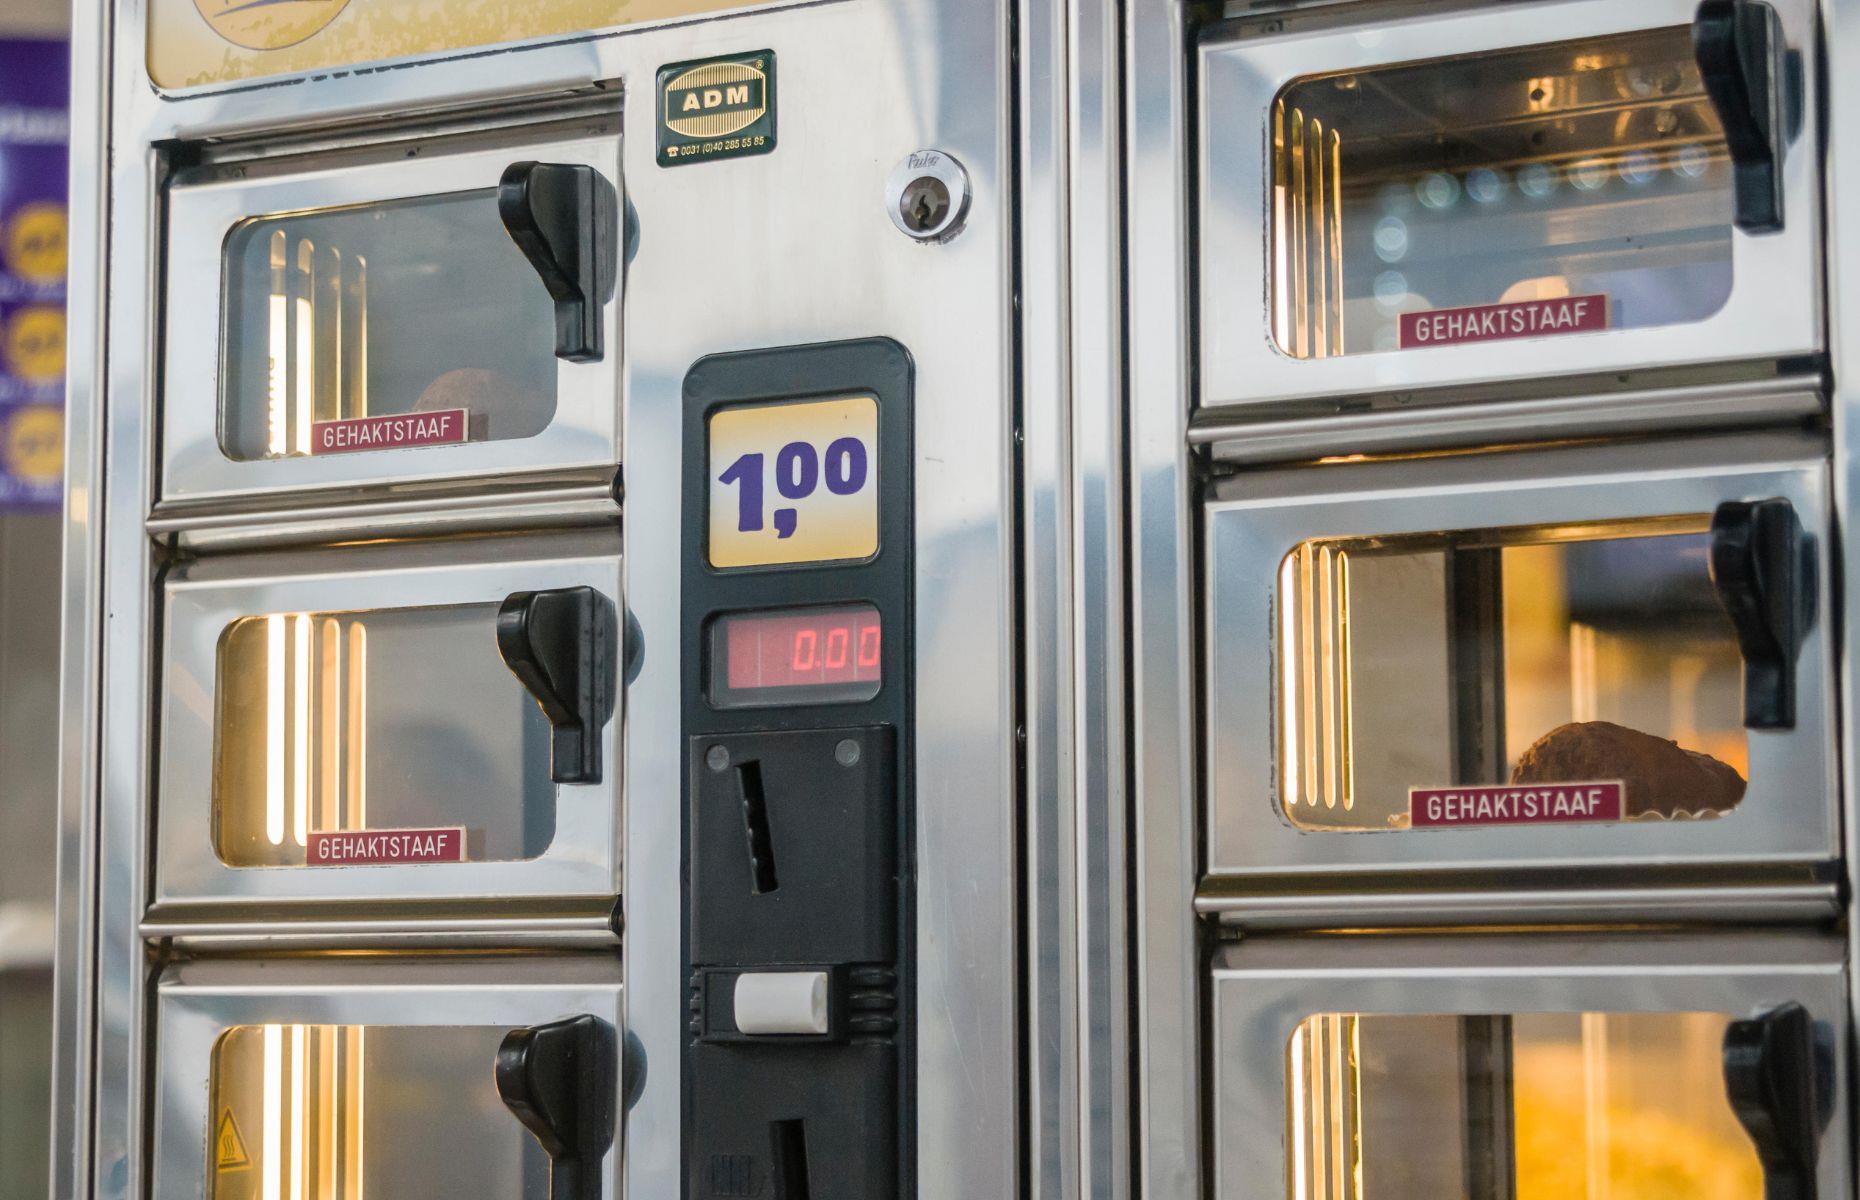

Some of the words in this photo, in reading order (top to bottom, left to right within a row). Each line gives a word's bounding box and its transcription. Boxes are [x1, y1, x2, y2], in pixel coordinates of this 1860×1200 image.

[682, 85, 749, 111] ADM
[681, 145, 700, 156] 0031
[702, 142, 723, 154] (0)40
[724, 140, 740, 150] 285
[1415, 302, 1588, 342] GEHAKTSTAAF
[323, 416, 451, 448] GEHAKTSTAAF
[718, 437, 867, 539] 1,00
[793, 626, 880, 671] 0.00
[1427, 789, 1602, 821] GEHAKTSTAAF
[318, 834, 448, 860] GEHAKTSTAAF
